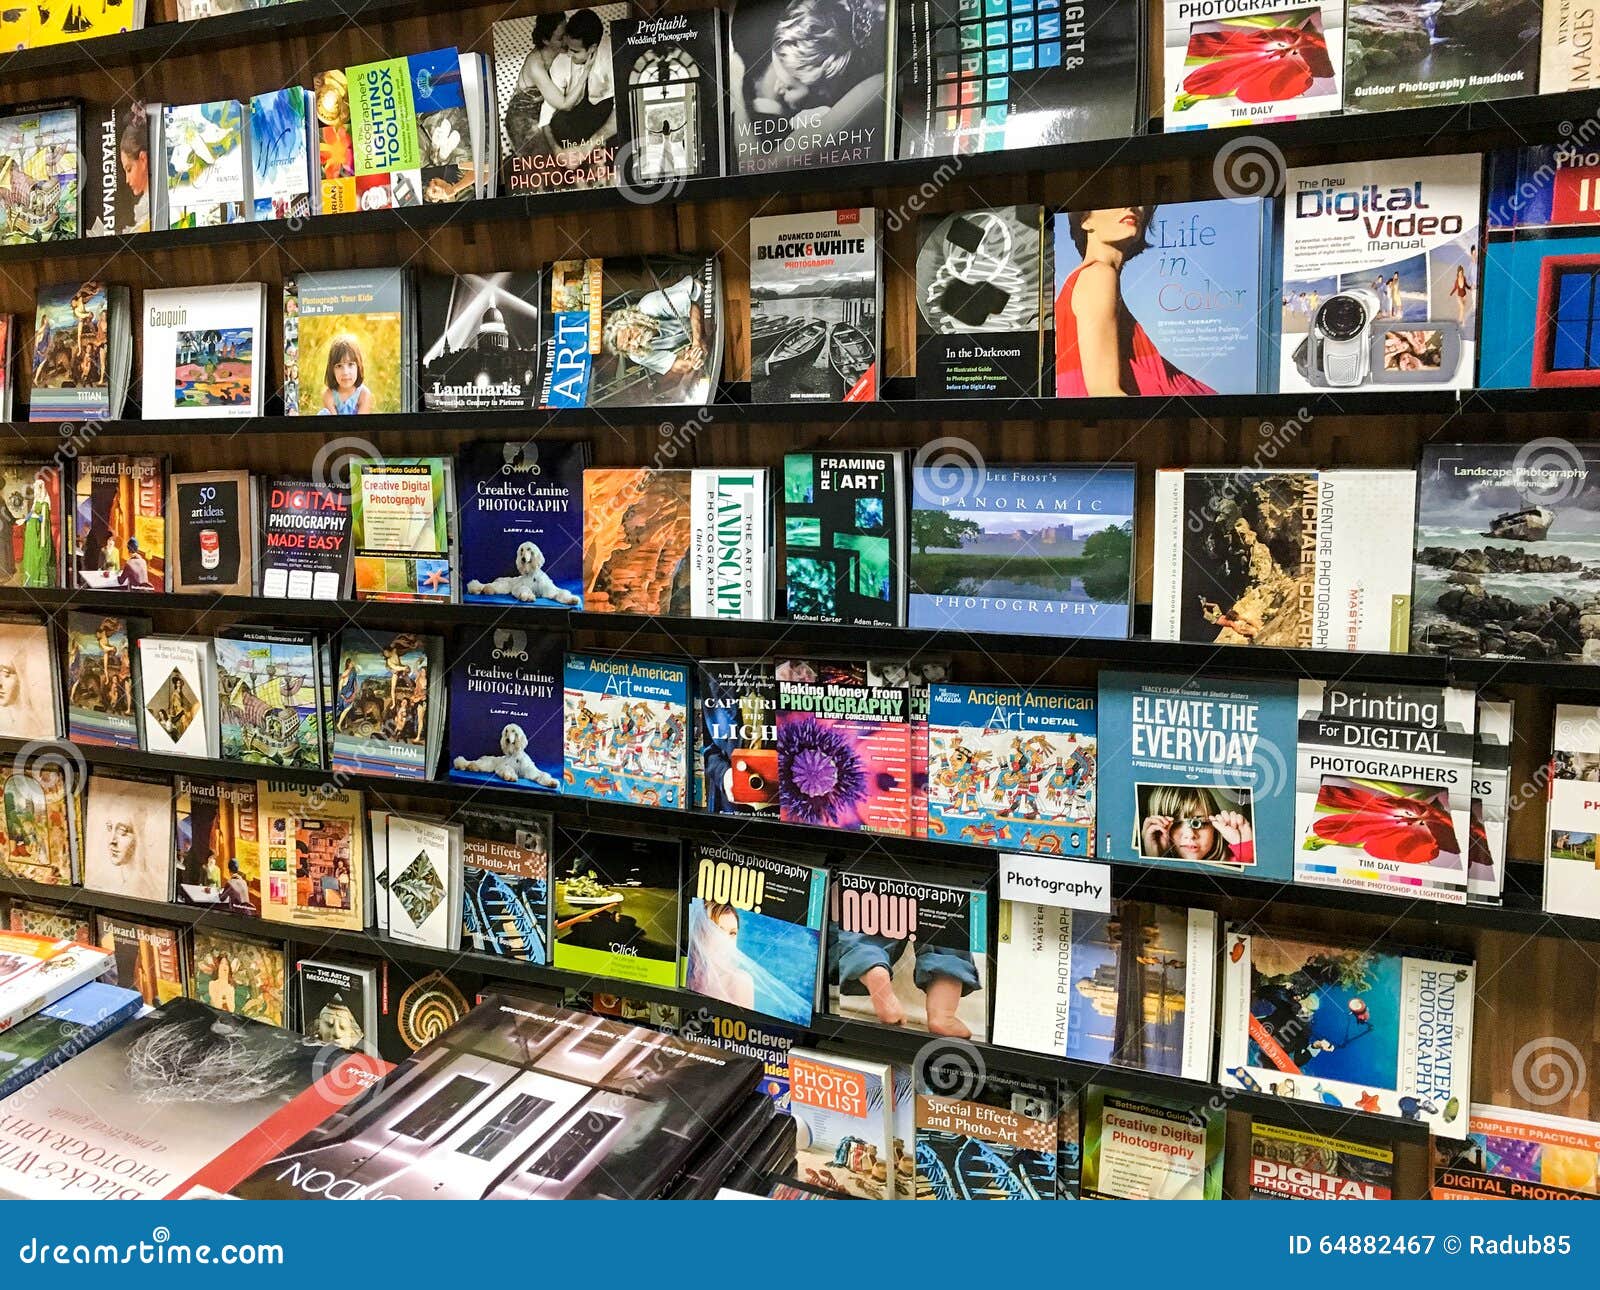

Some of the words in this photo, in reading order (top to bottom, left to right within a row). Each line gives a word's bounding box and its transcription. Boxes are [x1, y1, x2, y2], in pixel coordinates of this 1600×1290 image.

[637, 15, 688, 35] Profitable
[627, 36, 657, 46] Wedding
[658, 30, 699, 43] Photography
[1355, 85, 1395, 97] Outdoor
[1398, 77, 1466, 94] Photography
[1469, 69, 1525, 86] Handbook
[358, 73, 373, 170] Photographer's
[366, 69, 388, 168] LIGHTING
[380, 67, 401, 166] TOOLBOX
[1231, 108, 1247, 118] TIM
[1250, 105, 1274, 116] DALY
[738, 114, 822, 137] WEDDING
[561, 138, 578, 149] The
[738, 127, 876, 157] PHOTOGRAPHY
[512, 146, 619, 172] ENGAGEMEN
[738, 159, 780, 173] FROM
[786, 152, 812, 169] THE
[820, 146, 872, 164] HEART
[101, 120, 116, 236] FRAGONAR
[510, 165, 621, 190] PHOTOGRAPH
[1298, 179, 1319, 188] The
[1322, 177, 1345, 187] New
[1296, 181, 1430, 222] Digital
[778, 232, 814, 242] ADVANCED
[816, 230, 841, 239] DIGITAL
[1158, 214, 1217, 249] Life
[1362, 213, 1463, 239] Video
[1368, 238, 1427, 252] Manual
[784, 259, 835, 269] PHOTOGRAPHY
[1160, 251, 1188, 277] in
[358, 294, 374, 302] Kids
[1158, 279, 1247, 312] Color
[150, 306, 187, 328] Gauguin
[302, 305, 316, 314] Like
[322, 304, 334, 313] Pro
[546, 339, 556, 369] PHOTO
[553, 315, 588, 403] ART
[946, 348, 956, 359] In
[959, 348, 973, 358] the
[974, 347, 1021, 358] Darkroom
[77, 391, 102, 401] TITIAN
[433, 382, 521, 397] Landmarks
[540, 371, 554, 404] DIGITAL
[499, 399, 524, 407] Pictures
[81, 461, 116, 475] Edward
[118, 462, 156, 480] Hopper
[820, 458, 885, 471] FRAMING
[1454, 466, 1513, 479] Landscape
[1515, 466, 1590, 480] Photography
[364, 480, 400, 491] Creative
[402, 479, 431, 492] Digital
[477, 481, 526, 497] Creative
[528, 481, 569, 497] Canine
[820, 470, 830, 490] RE
[199, 486, 217, 506] 50
[271, 489, 347, 511] DIGITAL
[369, 495, 426, 506] Photography
[478, 497, 569, 513] PHOTOGRAPHY
[941, 497, 1102, 512] PANORAMIC
[191, 507, 203, 518] art
[203, 506, 225, 517] ideas
[269, 513, 346, 531] PHOTOGRAPHY
[1319, 482, 1334, 557] ADVENTURE
[1299, 480, 1318, 575] MICHAEL
[267, 532, 305, 548] MADE
[308, 534, 343, 550] EASY
[706, 491, 715, 607] PHOTOGRAPHY
[745, 579, 752, 598] OF
[935, 597, 1099, 616] PHOTOGRAPHY
[1298, 584, 1315, 648] CLARK
[793, 613, 819, 622] Michael
[820, 615, 842, 623] Carter
[854, 618, 872, 626] Adam
[468, 663, 513, 680] Creative
[515, 666, 555, 683] Canine
[589, 659, 629, 677] Ancient
[631, 663, 684, 683] American
[468, 679, 554, 698] PHOTOGRAPHY
[604, 675, 633, 697] Art
[633, 685, 643, 693] IN
[643, 686, 672, 696] DETAIL
[779, 682, 824, 698] Making
[827, 684, 870, 700] Money
[871, 687, 903, 700] from
[1163, 687, 1180, 695] CLARK
[1230, 692, 1249, 700] Sisters
[780, 694, 904, 716] PHOTOGRAPHY
[967, 690, 1022, 707] Ancient
[1024, 692, 1094, 711] American
[1330, 691, 1439, 728] Printing
[823, 712, 844, 720] EVERY
[845, 713, 888, 722] CONCEIVABLE
[987, 706, 1026, 730] Art
[1027, 716, 1039, 724] IN
[1041, 716, 1079, 727] DETAIL
[1132, 696, 1214, 729] ELEVATE
[1219, 703, 1259, 733] THE
[711, 724, 777, 742] LIGH
[1319, 724, 1340, 737] For
[1343, 724, 1446, 754] DIGITAL
[389, 746, 417, 759] TITIAN
[1131, 723, 1259, 767] EVERYDAY
[1310, 755, 1458, 784] PHOTOGRAPHERS
[180, 781, 215, 797] Edward
[216, 787, 255, 805] Hopper
[490, 844, 521, 860] Effects
[476, 854, 521, 873] Photo-Art
[699, 845, 745, 866] wedding
[746, 854, 809, 883] photography
[1358, 859, 1375, 870] TIM
[1377, 861, 1400, 872] DALY
[842, 874, 876, 893] baby
[879, 880, 965, 907] photography
[1007, 871, 1103, 899] Photography
[1342, 877, 1366, 888] ADOBE
[1367, 880, 1411, 894] PHOTOSHOP
[1419, 888, 1463, 902] LIGHTROOM
[102, 921, 135, 938] Edward
[712, 1016, 747, 1041] 100
[748, 1029, 793, 1051] Clever
[1054, 1000, 1068, 1048] TRAVEL
[1416, 971, 1437, 1100] PHOTOGRAPHY
[1433, 971, 1456, 1102] UNDERWATER
[724, 1039, 789, 1065] Photograph
[793, 1066, 860, 1097] PHOTO
[795, 1085, 861, 1114] STYLIST
[1115, 1100, 1164, 1117] BetterPhoto
[927, 1099, 972, 1119] Special
[975, 1107, 1018, 1127] Effects
[927, 1115, 950, 1128] and
[955, 1119, 1018, 1142] Photo-Art
[1106, 1113, 1158, 1135] Creative
[1161, 1125, 1204, 1146] Digital
[1470, 1120, 1526, 1137] COMPLETE
[1528, 1128, 1591, 1148] PRACTICAL
[1112, 1131, 1195, 1160] Photography
[1253, 1159, 1384, 1200] DIGITAL
[1443, 1172, 1505, 1193] DIGITAL
